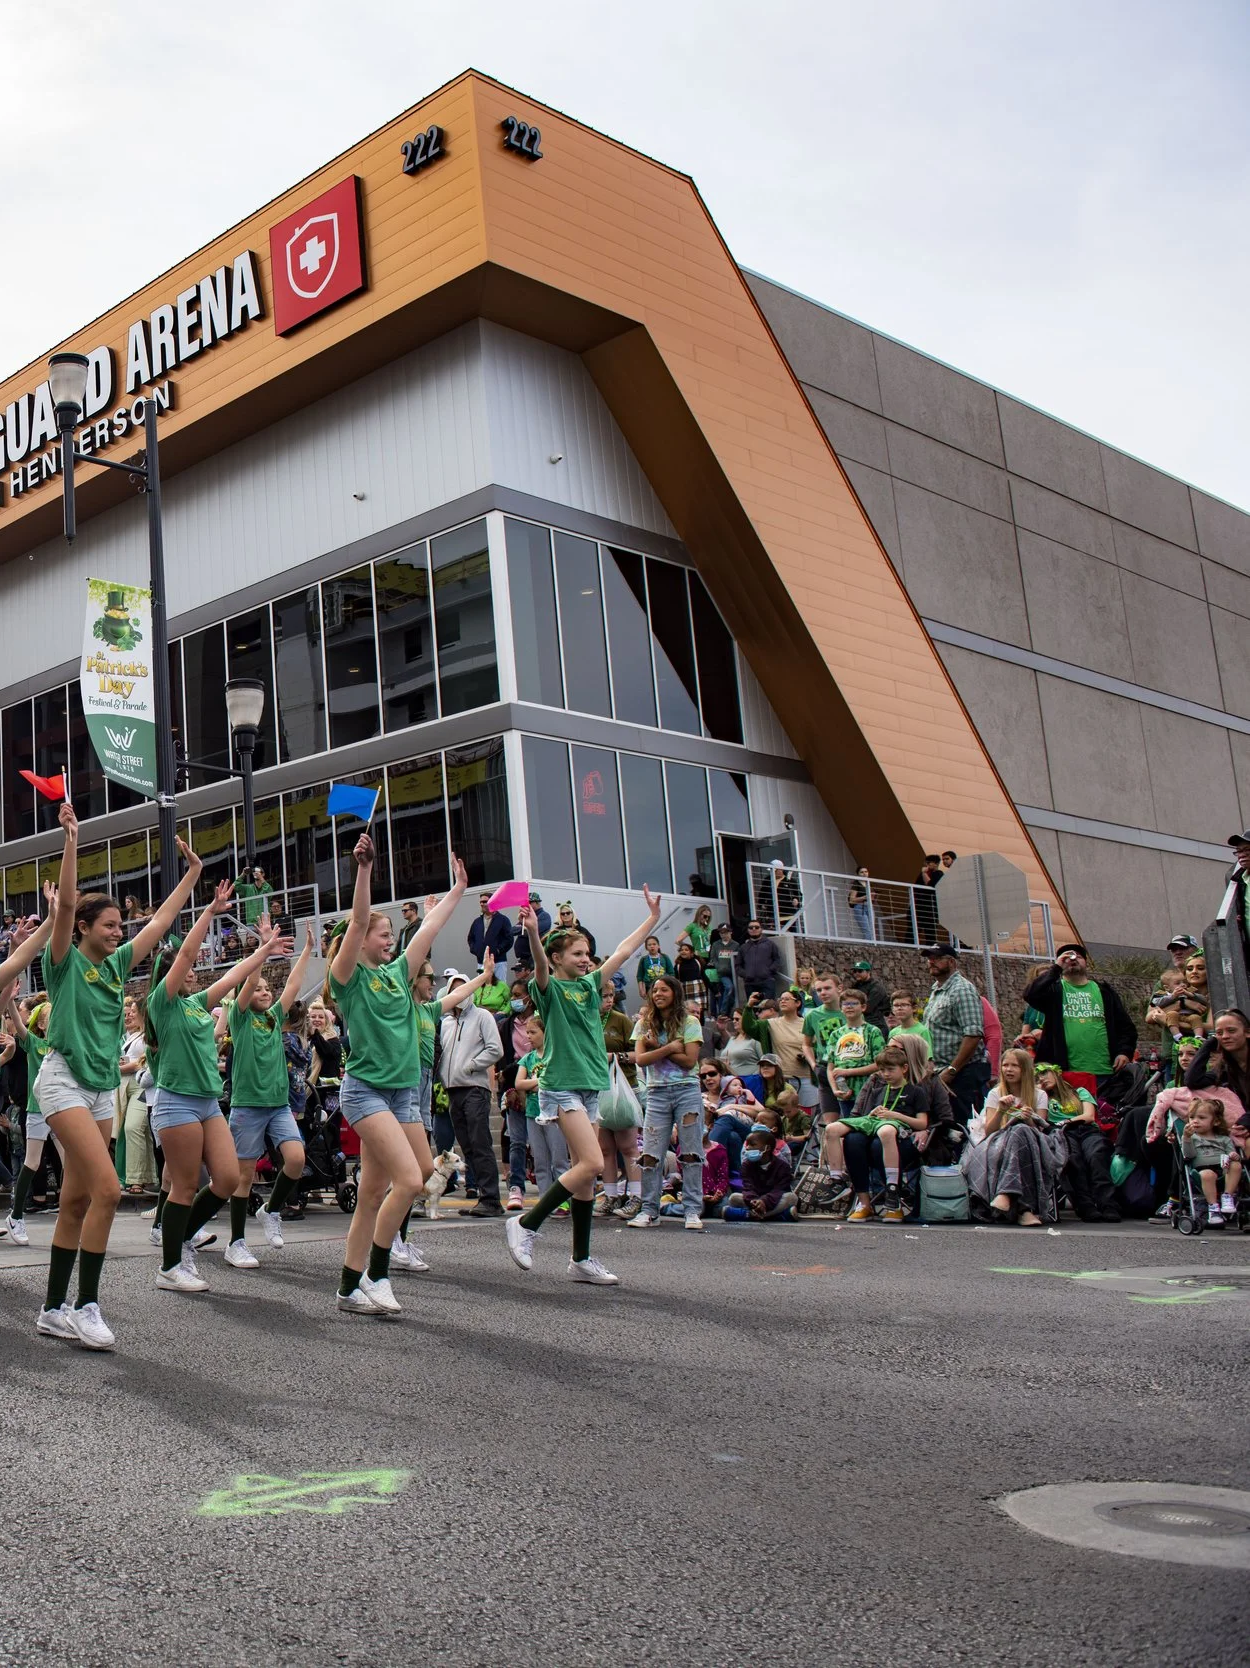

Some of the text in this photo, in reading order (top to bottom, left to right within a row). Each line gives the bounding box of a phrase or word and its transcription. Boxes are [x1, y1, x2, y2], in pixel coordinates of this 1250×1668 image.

[401, 125, 440, 172] 222
[506, 116, 543, 158] 222
[125, 249, 261, 394] ARENA
[10, 380, 170, 498] HENERSON
[86, 656, 149, 677] Patrick's
[98, 673, 136, 700] Day
[88, 696, 148, 711] Festival & Parade
[121, 755, 143, 767] STREET
[1062, 1010, 1105, 1018] ALLAGHE
